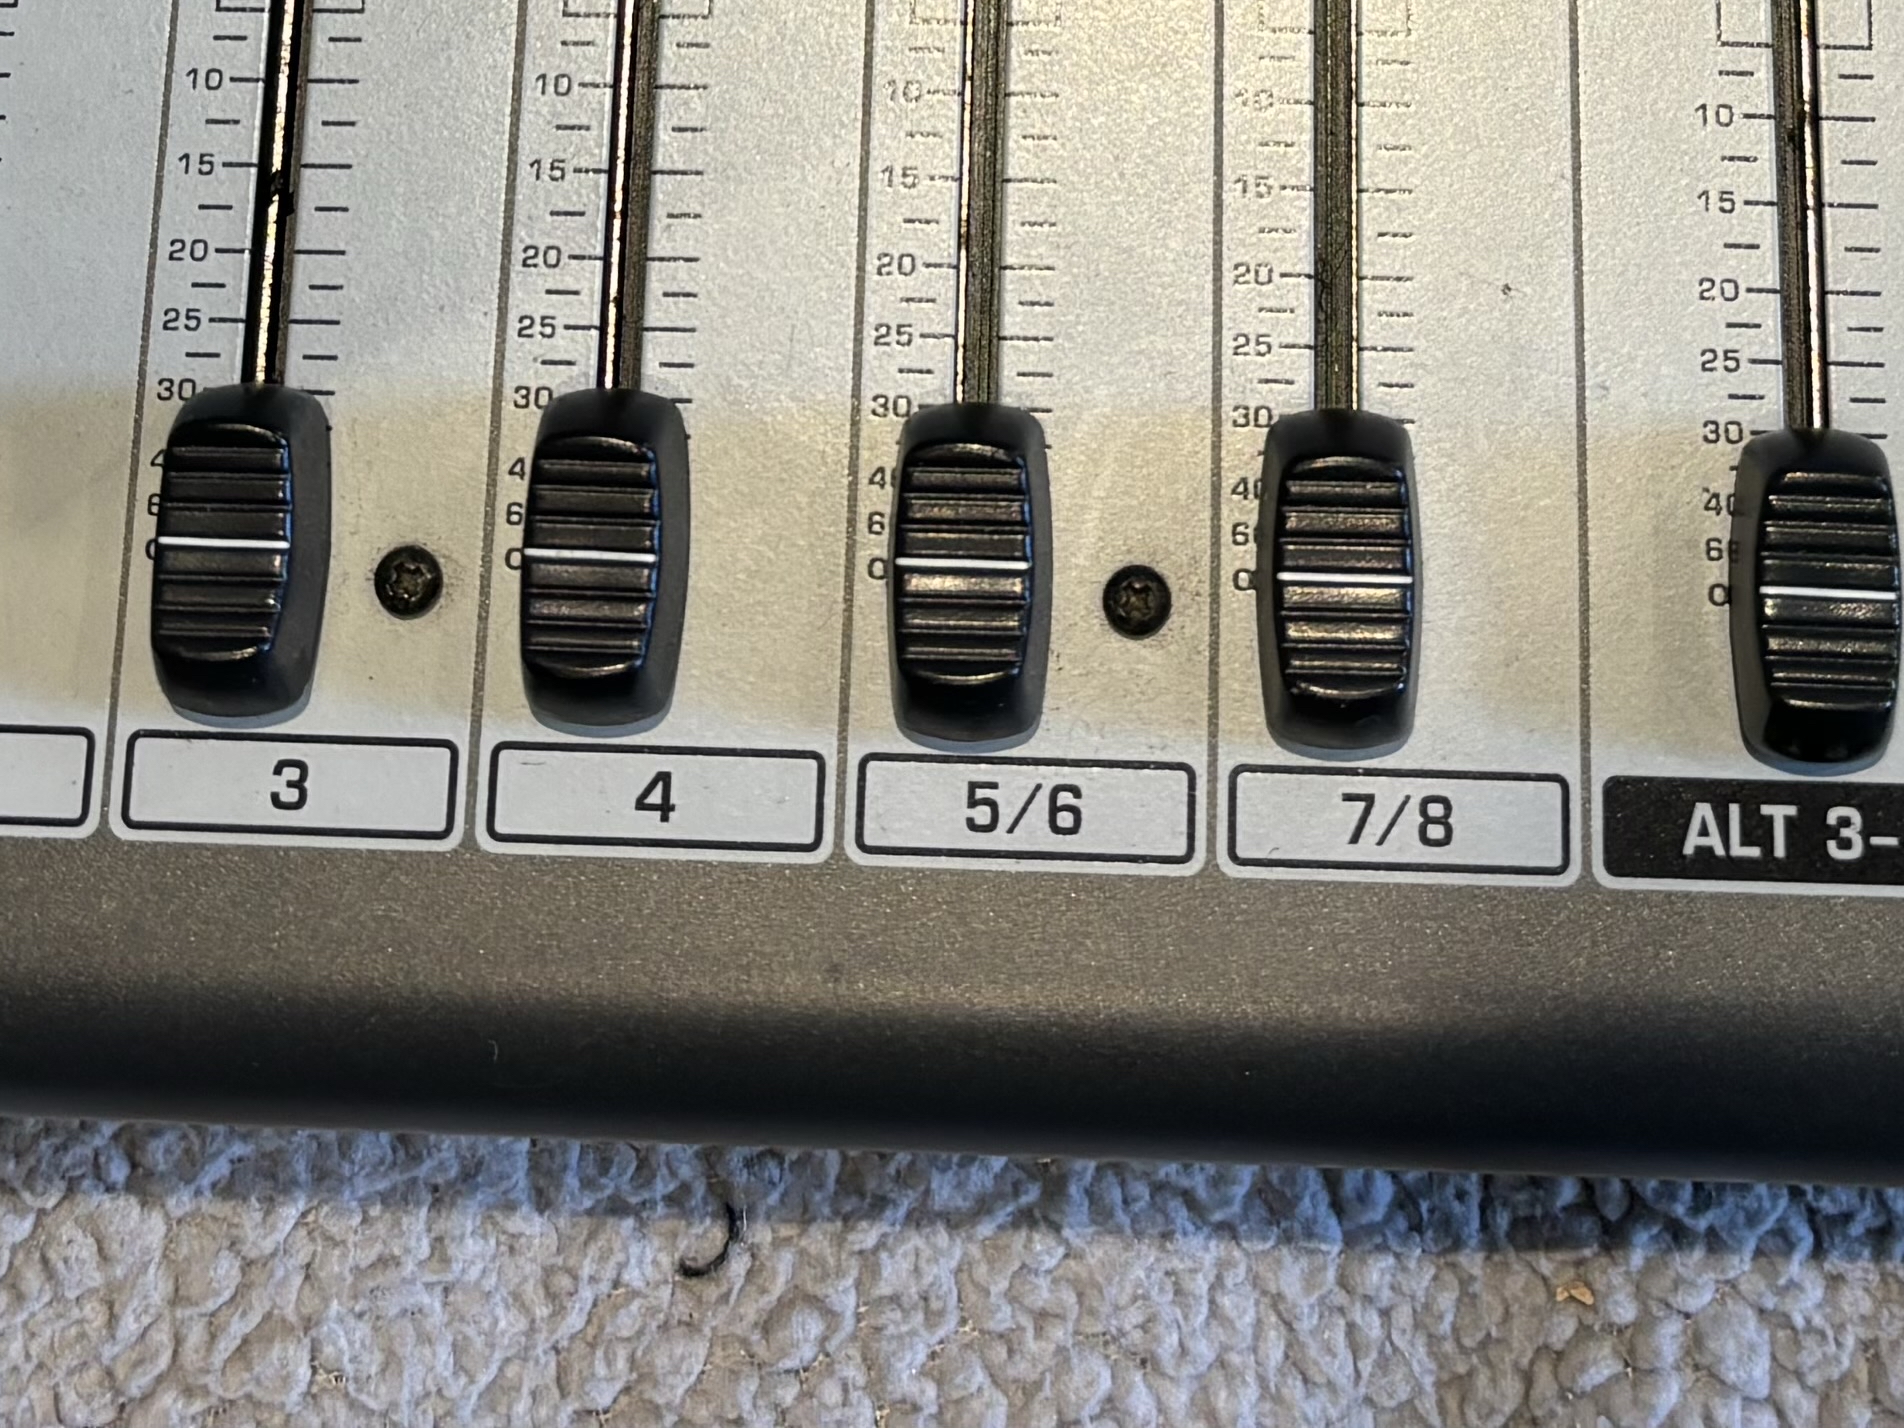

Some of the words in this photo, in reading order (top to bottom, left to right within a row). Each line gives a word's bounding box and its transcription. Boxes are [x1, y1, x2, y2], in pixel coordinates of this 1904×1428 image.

[270, 759, 309, 810] 3
[634, 771, 675, 822] 4
[965, 781, 1084, 835] 5/6
[1341, 793, 1455, 848] 7/8
[1682, 804, 1798, 859] ALT
